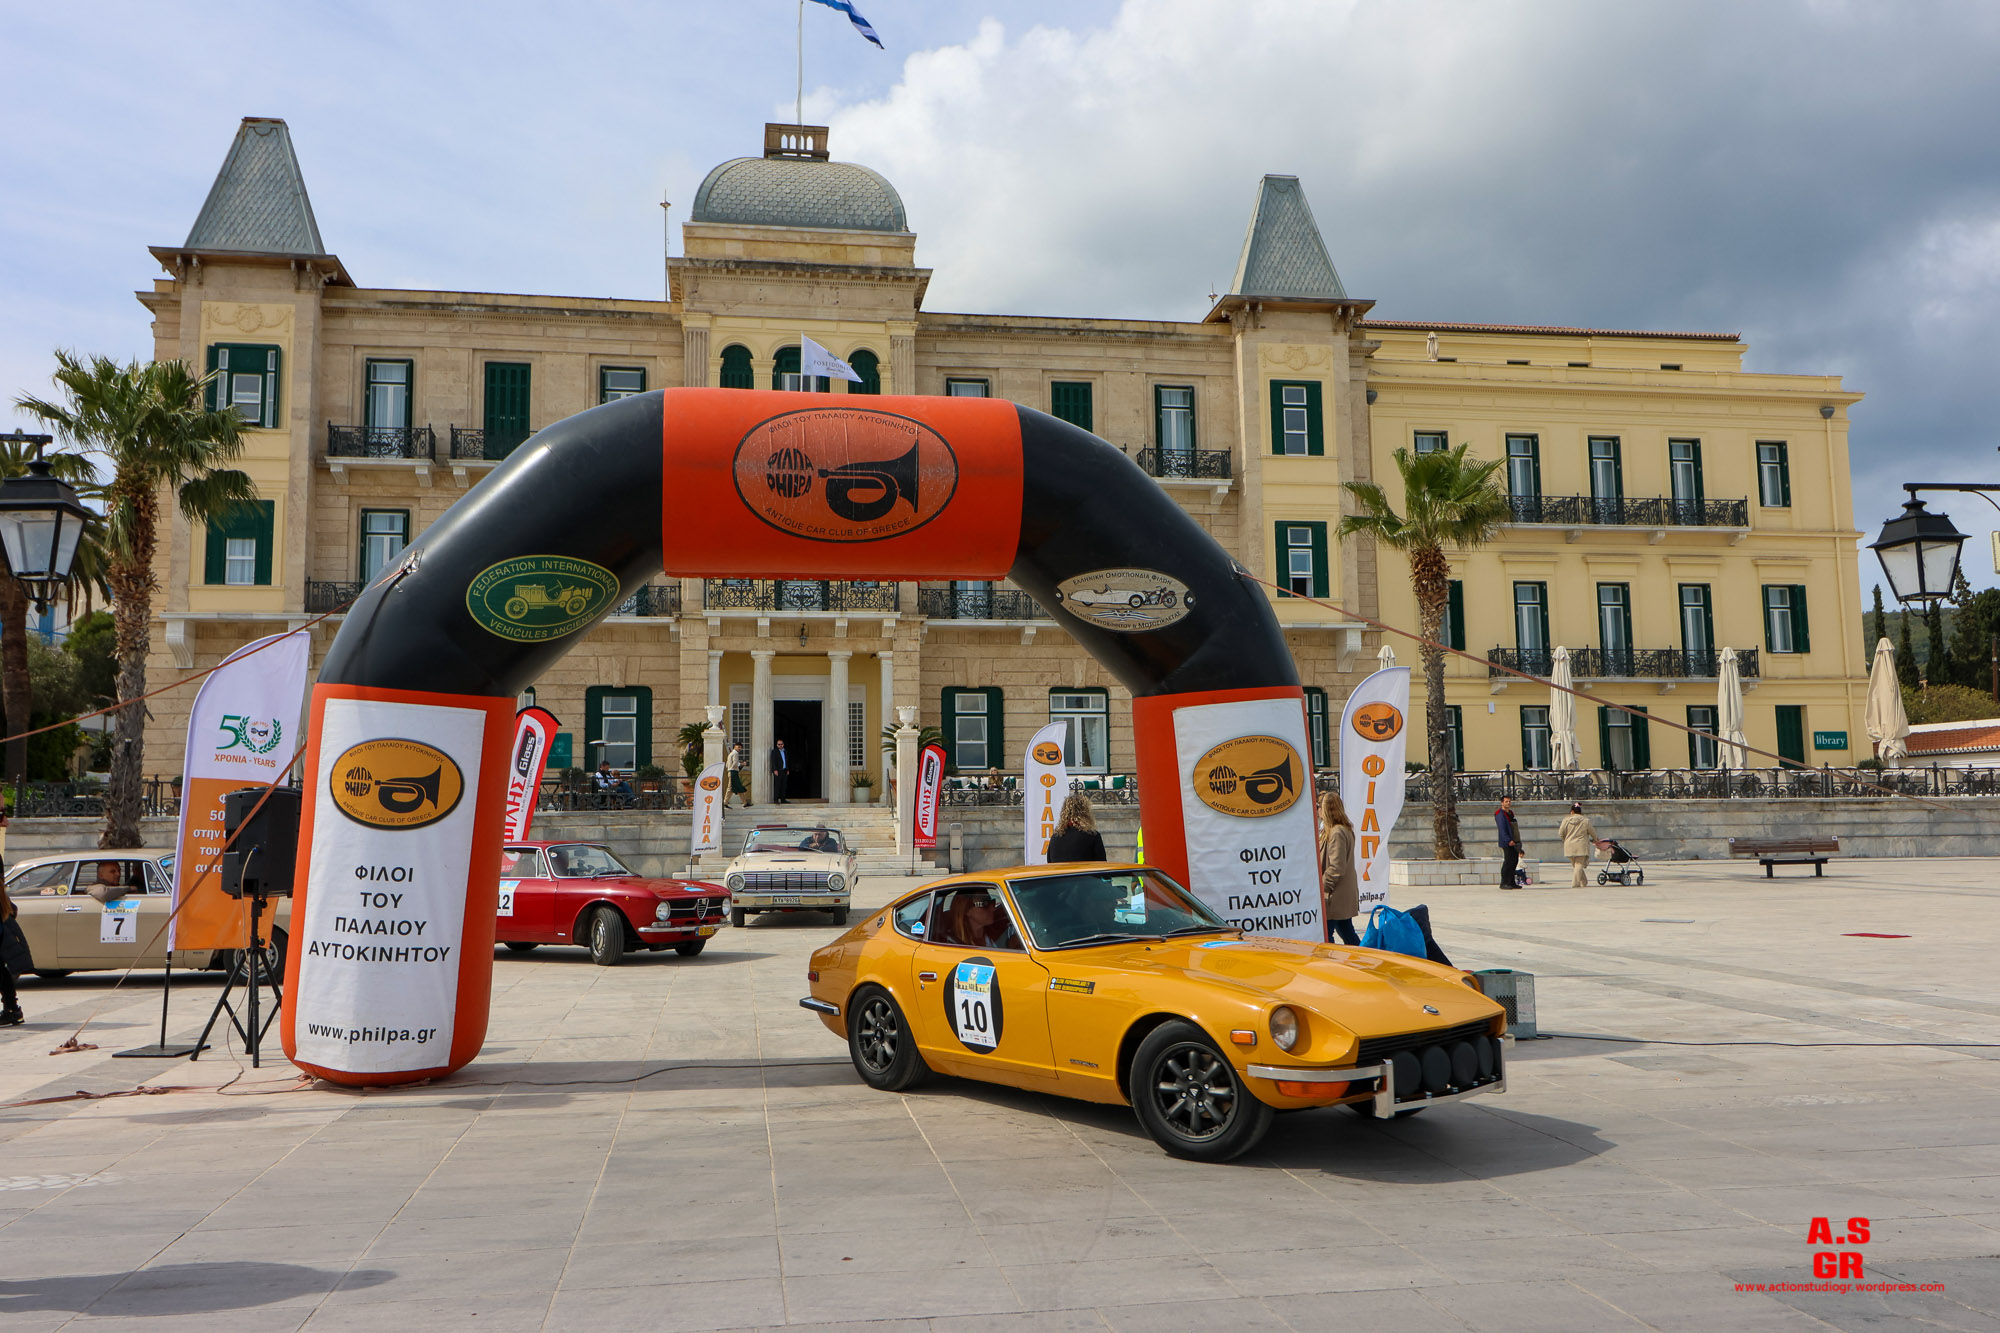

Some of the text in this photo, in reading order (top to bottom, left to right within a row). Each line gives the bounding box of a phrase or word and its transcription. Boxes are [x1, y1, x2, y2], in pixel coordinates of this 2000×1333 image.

[768, 420, 792, 433] ΦΙΛΟΙ
[793, 415, 811, 423] ΤΟΥ
[858, 415, 921, 435] ΑΥΤΟΚΙΝΗΤΟΥ
[766, 473, 812, 498] PHILPA
[765, 506, 910, 537] ANTIQUE CAR CLUB OF GREECE
[473, 560, 616, 597] FEDERATION INTERNATIONALE
[490, 612, 594, 639] VEHICULES ANCIENS
[1816, 734, 1845, 747] library
[214, 754, 247, 763] ΧΡΟΝΙΑ
[254, 757, 276, 767] YEARS
[405, 744, 444, 763] ΑΥΤΟΚΙΝΗΤΟΥ
[518, 737, 535, 771] Glass
[210, 810, 225, 821] 50
[343, 801, 364, 817] ANTIQUE
[365, 814, 377, 823] CAR
[407, 812, 432, 823] GREECE
[1211, 801, 1237, 813] ANTIQUE
[1274, 799, 1290, 811] GREECE
[702, 795, 713, 843] ΦΙΛΠΑ
[193, 829, 220, 840] στην
[200, 847, 221, 855] του
[1240, 846, 1285, 863] ΦΙΛΟΙ
[355, 865, 413, 882] ΦΙΛΟΙ
[1248, 869, 1281, 885] ΤΟΥ
[360, 892, 403, 908] ΤΟΥ
[1229, 889, 1301, 910] ΠΑΛΑΙΟΥ
[114, 918, 124, 935] 7
[335, 917, 427, 935] ΠΑΛΑΙΟΥ
[1226, 909, 1317, 932] ΤΟΚΙΝΗΤΟΥ
[309, 941, 450, 962] ΑΥΤΟΚΙΝΗΤΟΥ
[962, 999, 987, 1033] 10
[309, 1024, 436, 1045] www.philpa.gr
